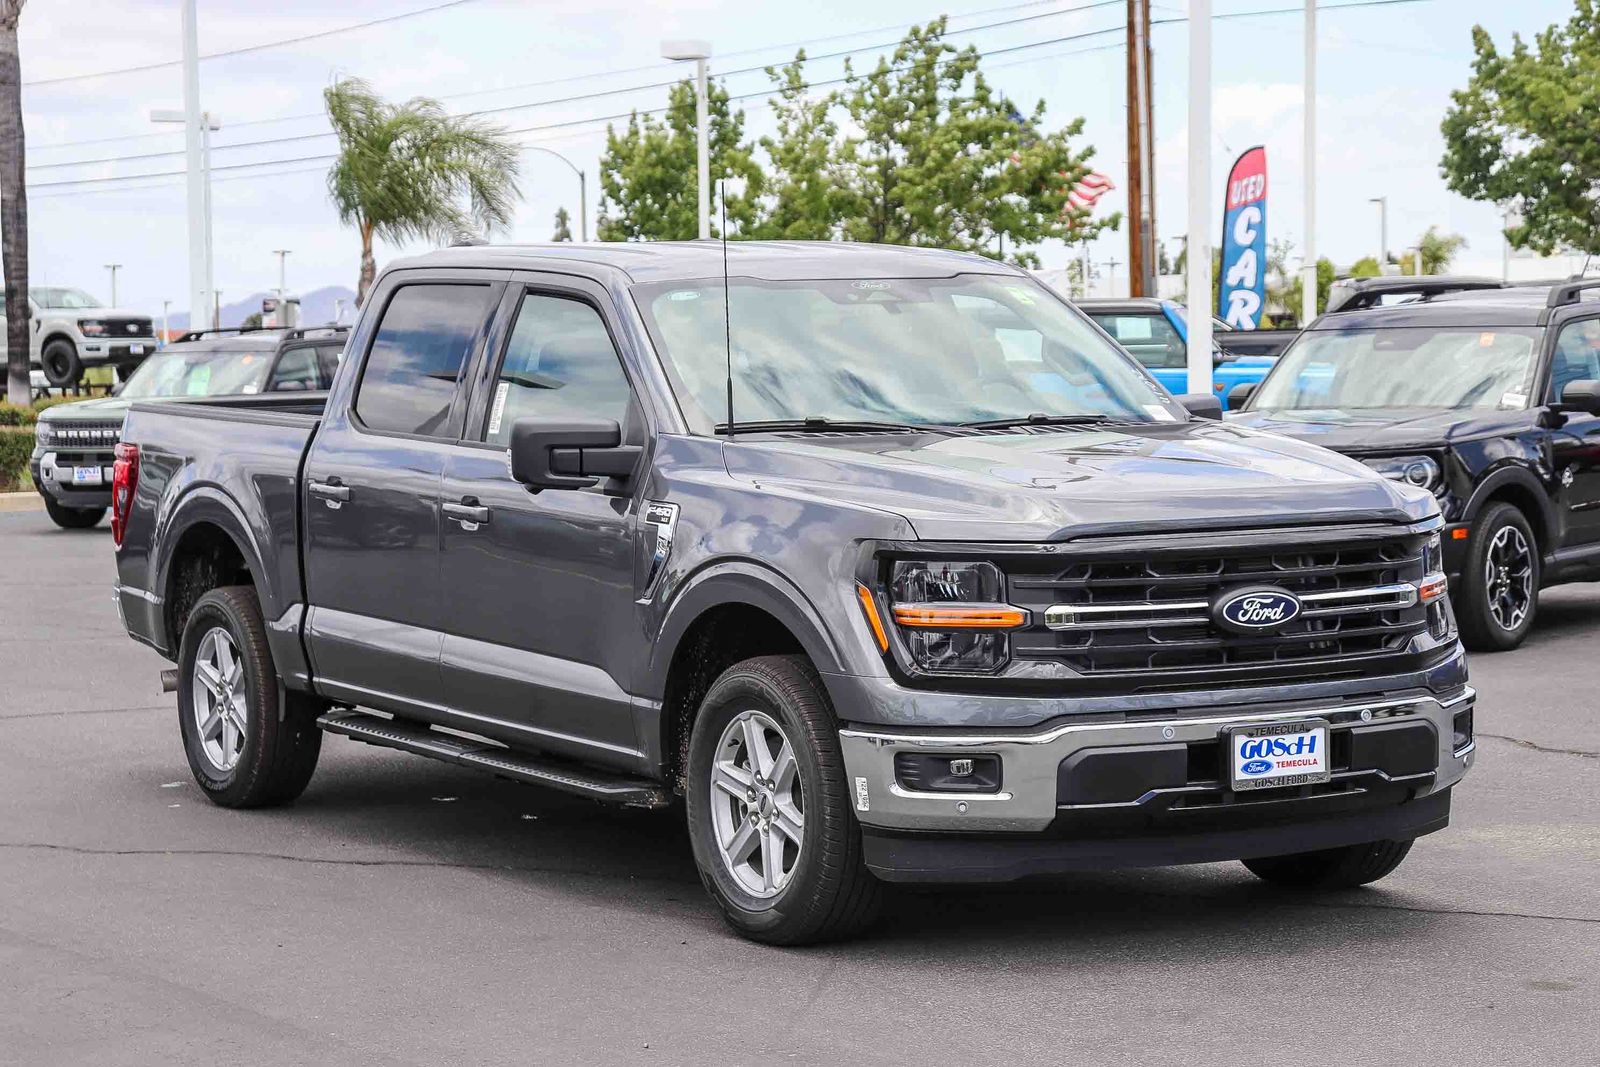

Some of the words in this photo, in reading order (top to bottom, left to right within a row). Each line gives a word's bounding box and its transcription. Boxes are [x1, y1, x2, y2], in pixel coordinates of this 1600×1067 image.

[1231, 173, 1265, 204] USED
[1238, 597, 1286, 622] Ford
[1255, 724, 1306, 736] TEMECULA
[1247, 762, 1267, 773] Ford
[1276, 758, 1318, 769] TEMECULA
[1286, 774, 1308, 785] FORD
